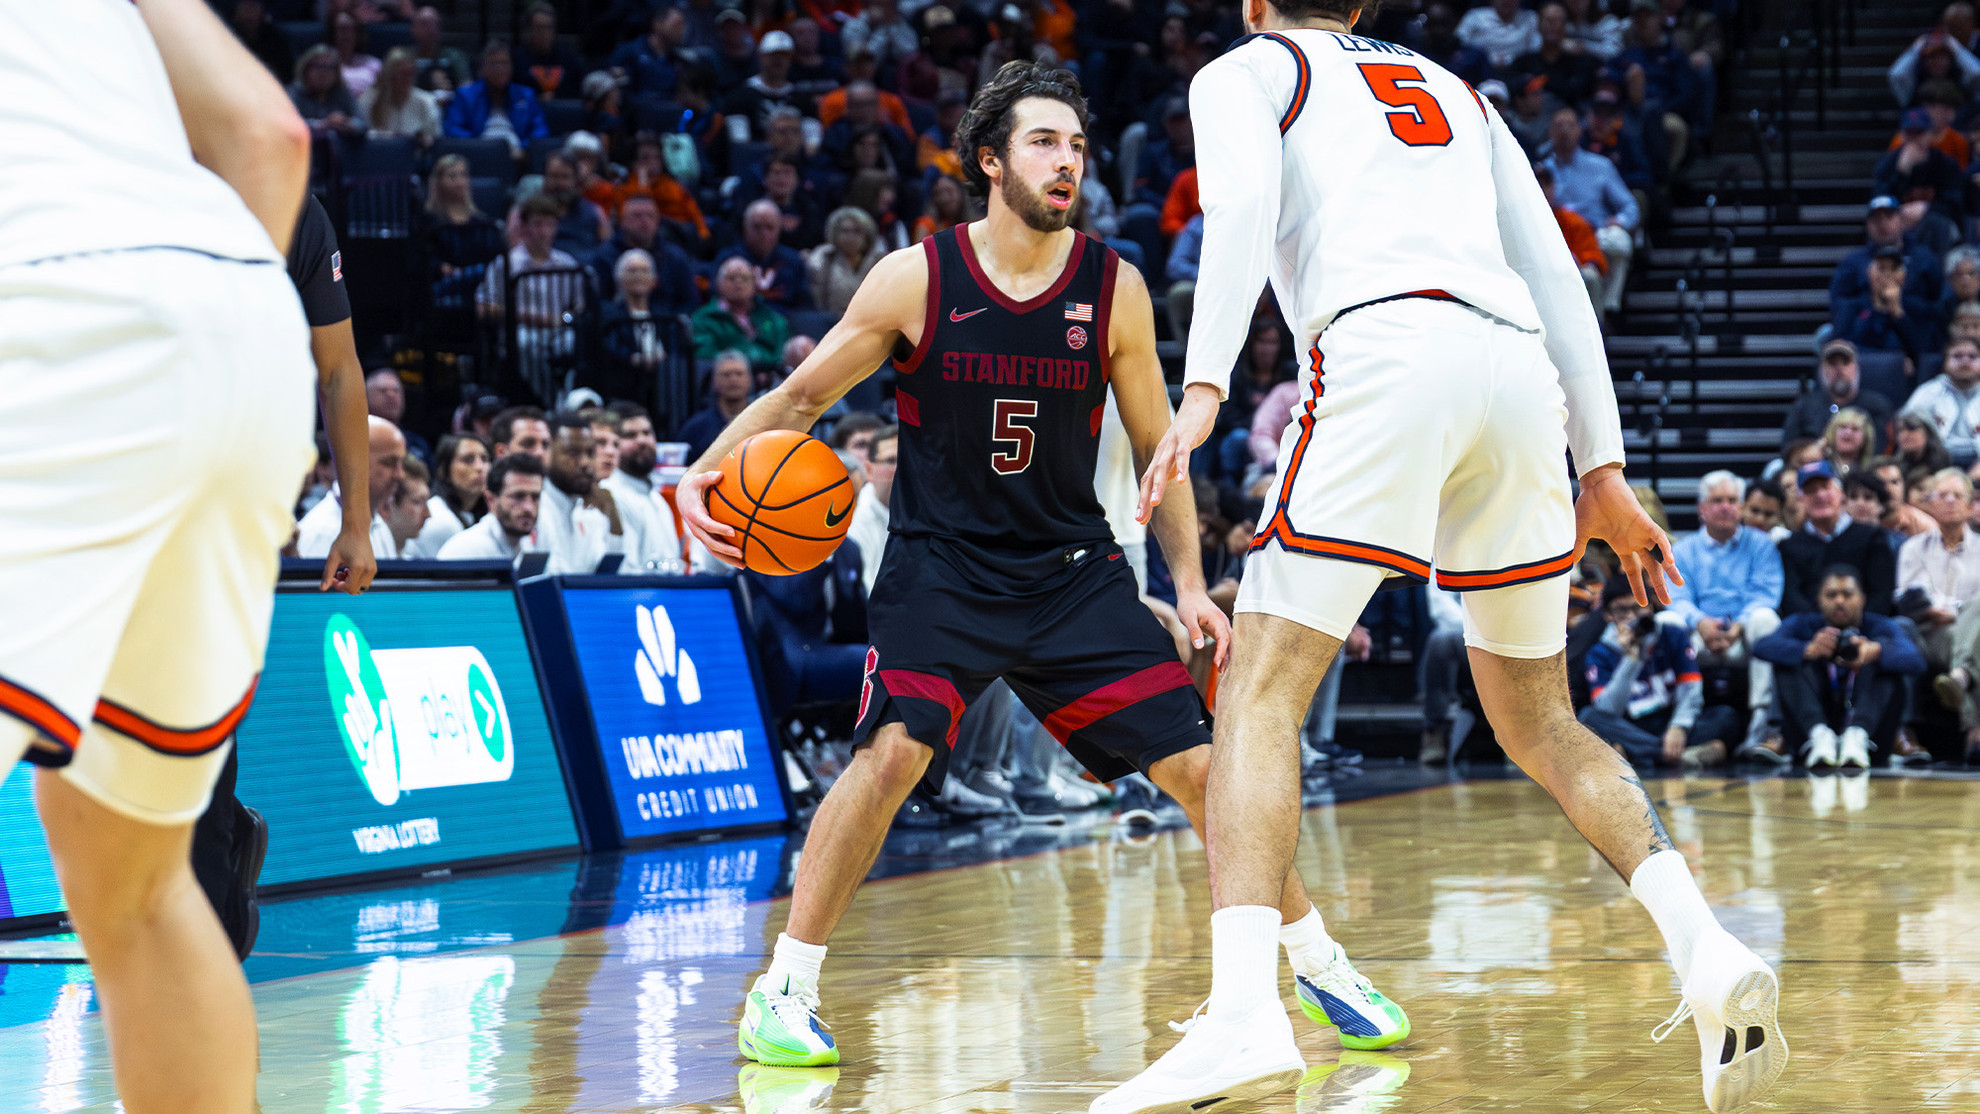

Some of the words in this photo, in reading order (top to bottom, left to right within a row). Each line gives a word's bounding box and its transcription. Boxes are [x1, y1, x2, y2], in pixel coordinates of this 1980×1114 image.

[1355, 62, 1454, 147] 5
[942, 351, 1090, 390] STANFORD
[991, 399, 1038, 475] 5
[420, 677, 471, 757] play
[621, 736, 662, 780] UVA
[654, 729, 748, 776] COMMUNITY
[637, 787, 699, 821] CREDIT
[704, 783, 759, 814] UNION
